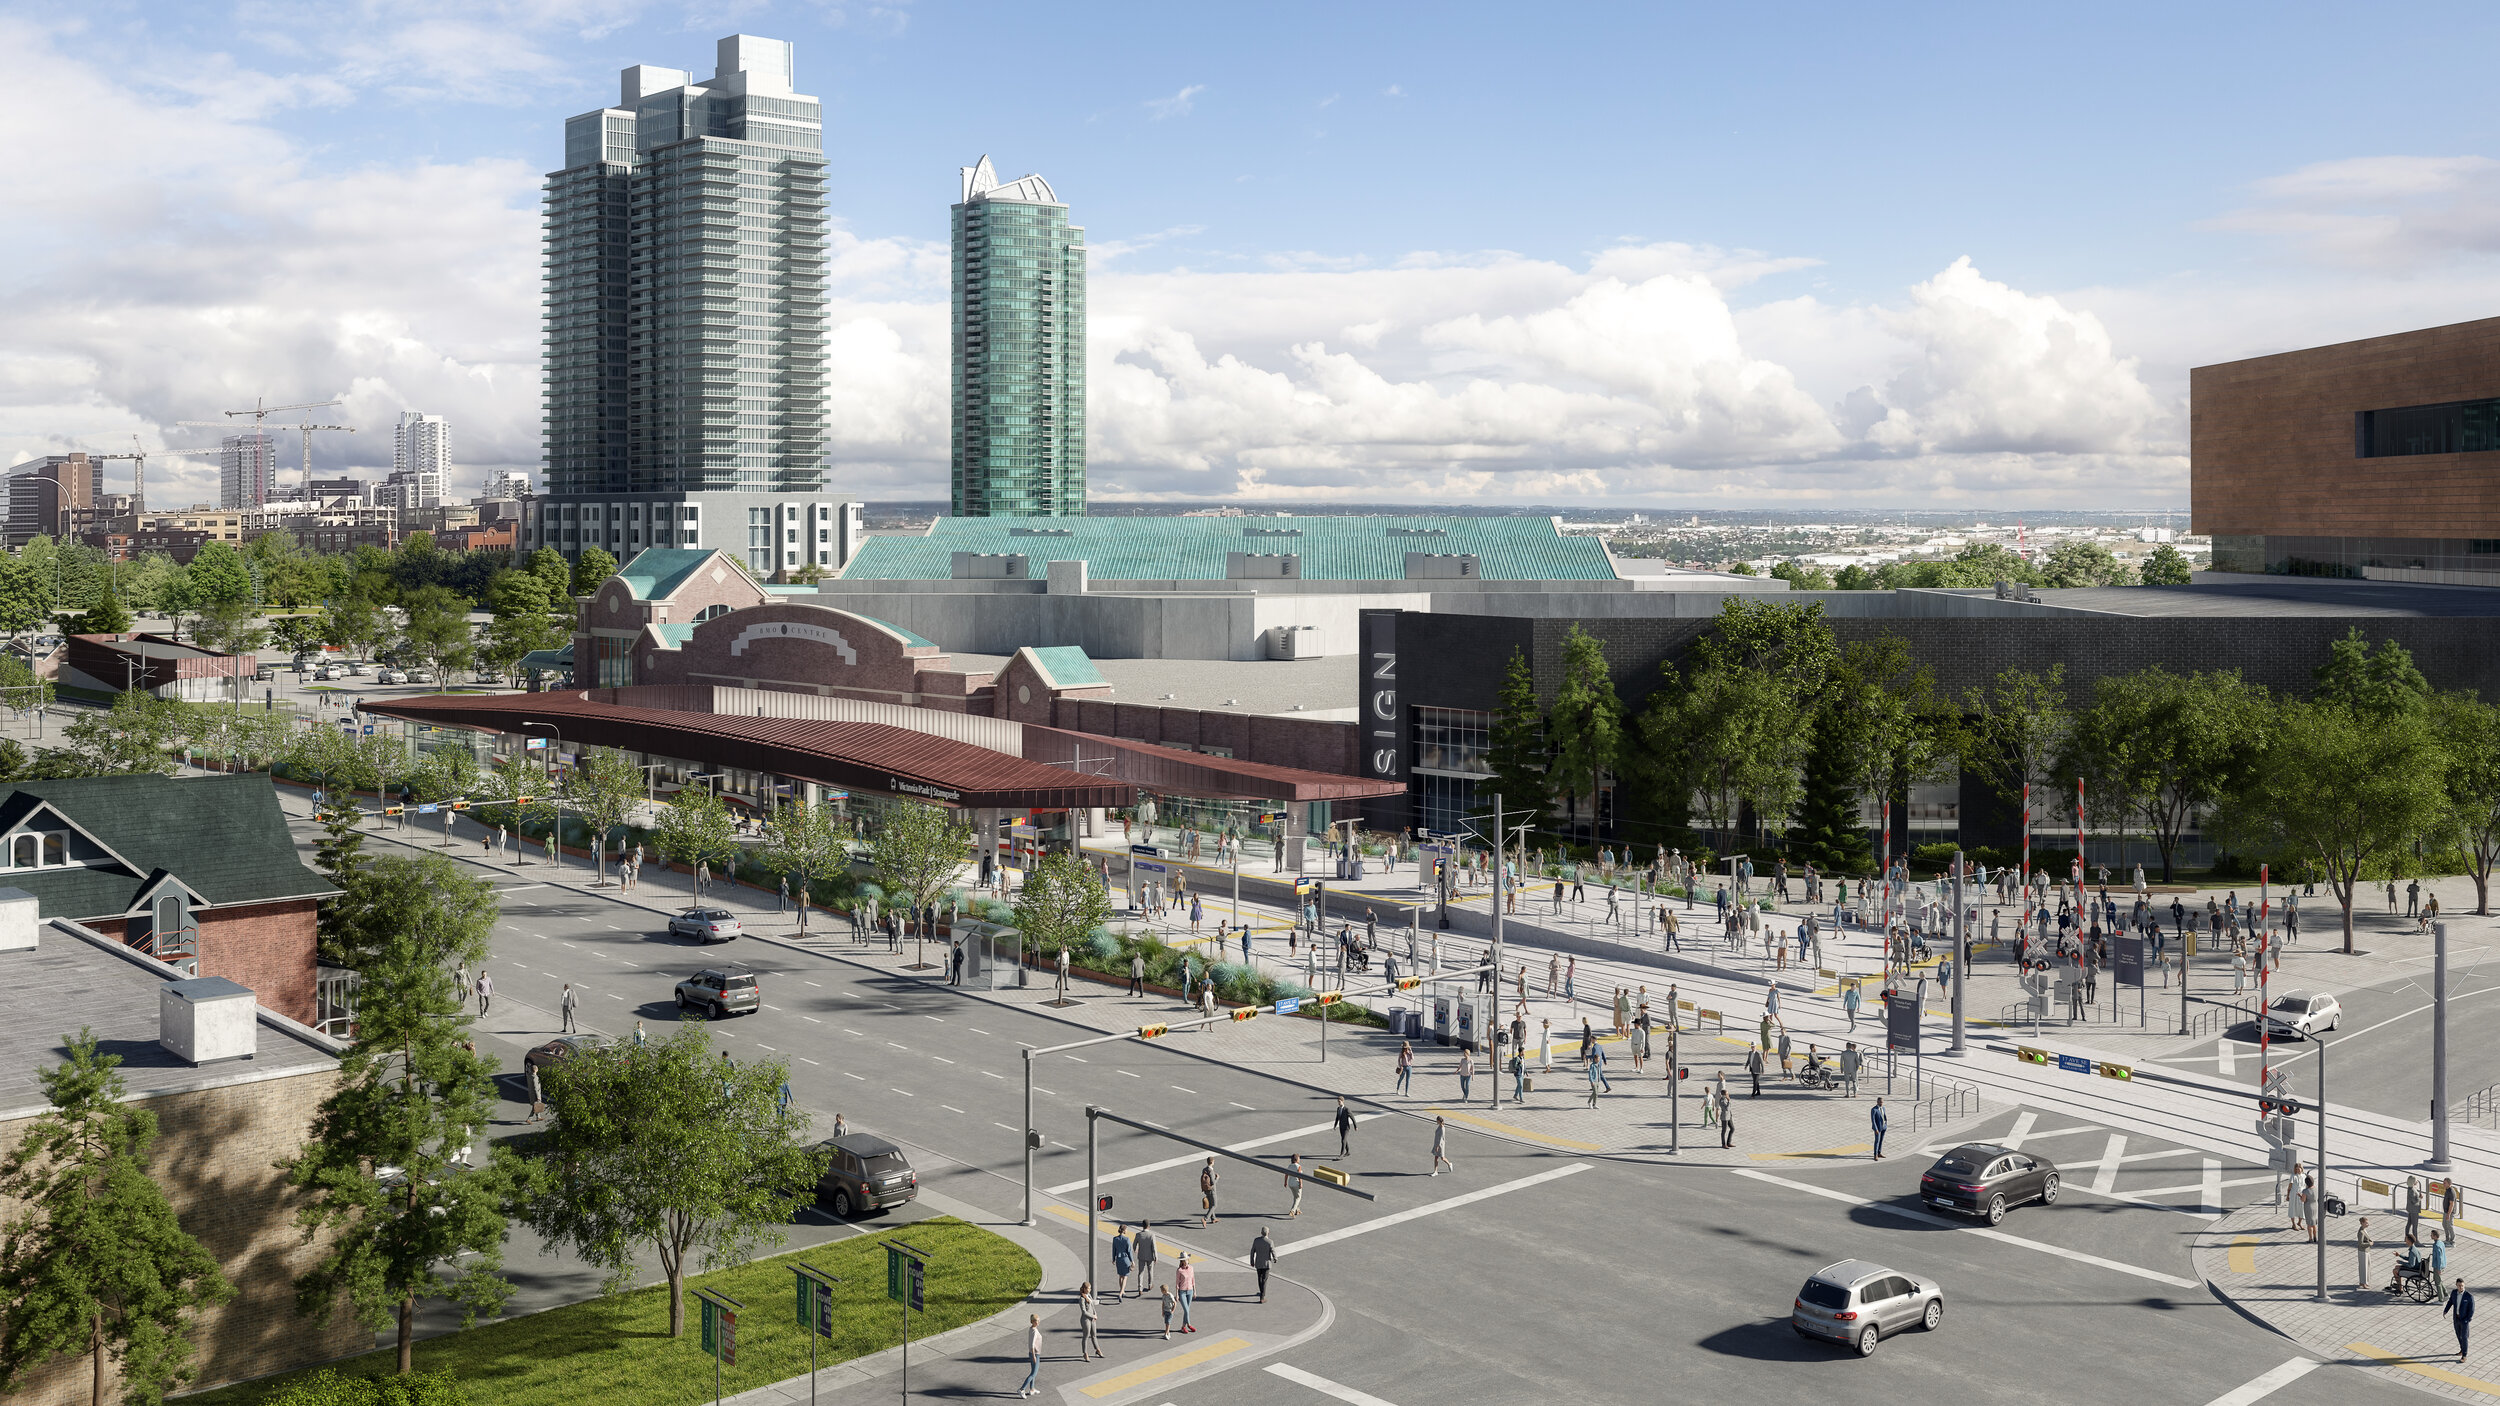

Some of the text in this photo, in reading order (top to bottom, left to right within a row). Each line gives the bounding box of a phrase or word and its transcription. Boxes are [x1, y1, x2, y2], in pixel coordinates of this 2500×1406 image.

[791, 627, 826, 639] CENTRE
[1373, 652, 1396, 776] SIGN
[898, 781, 960, 801] Victoria Park Stampede
[909, 1266, 923, 1280] COME
[915, 1279, 923, 1289] ON
[816, 1291, 831, 1306] COME
[823, 1304, 831, 1315] ON
